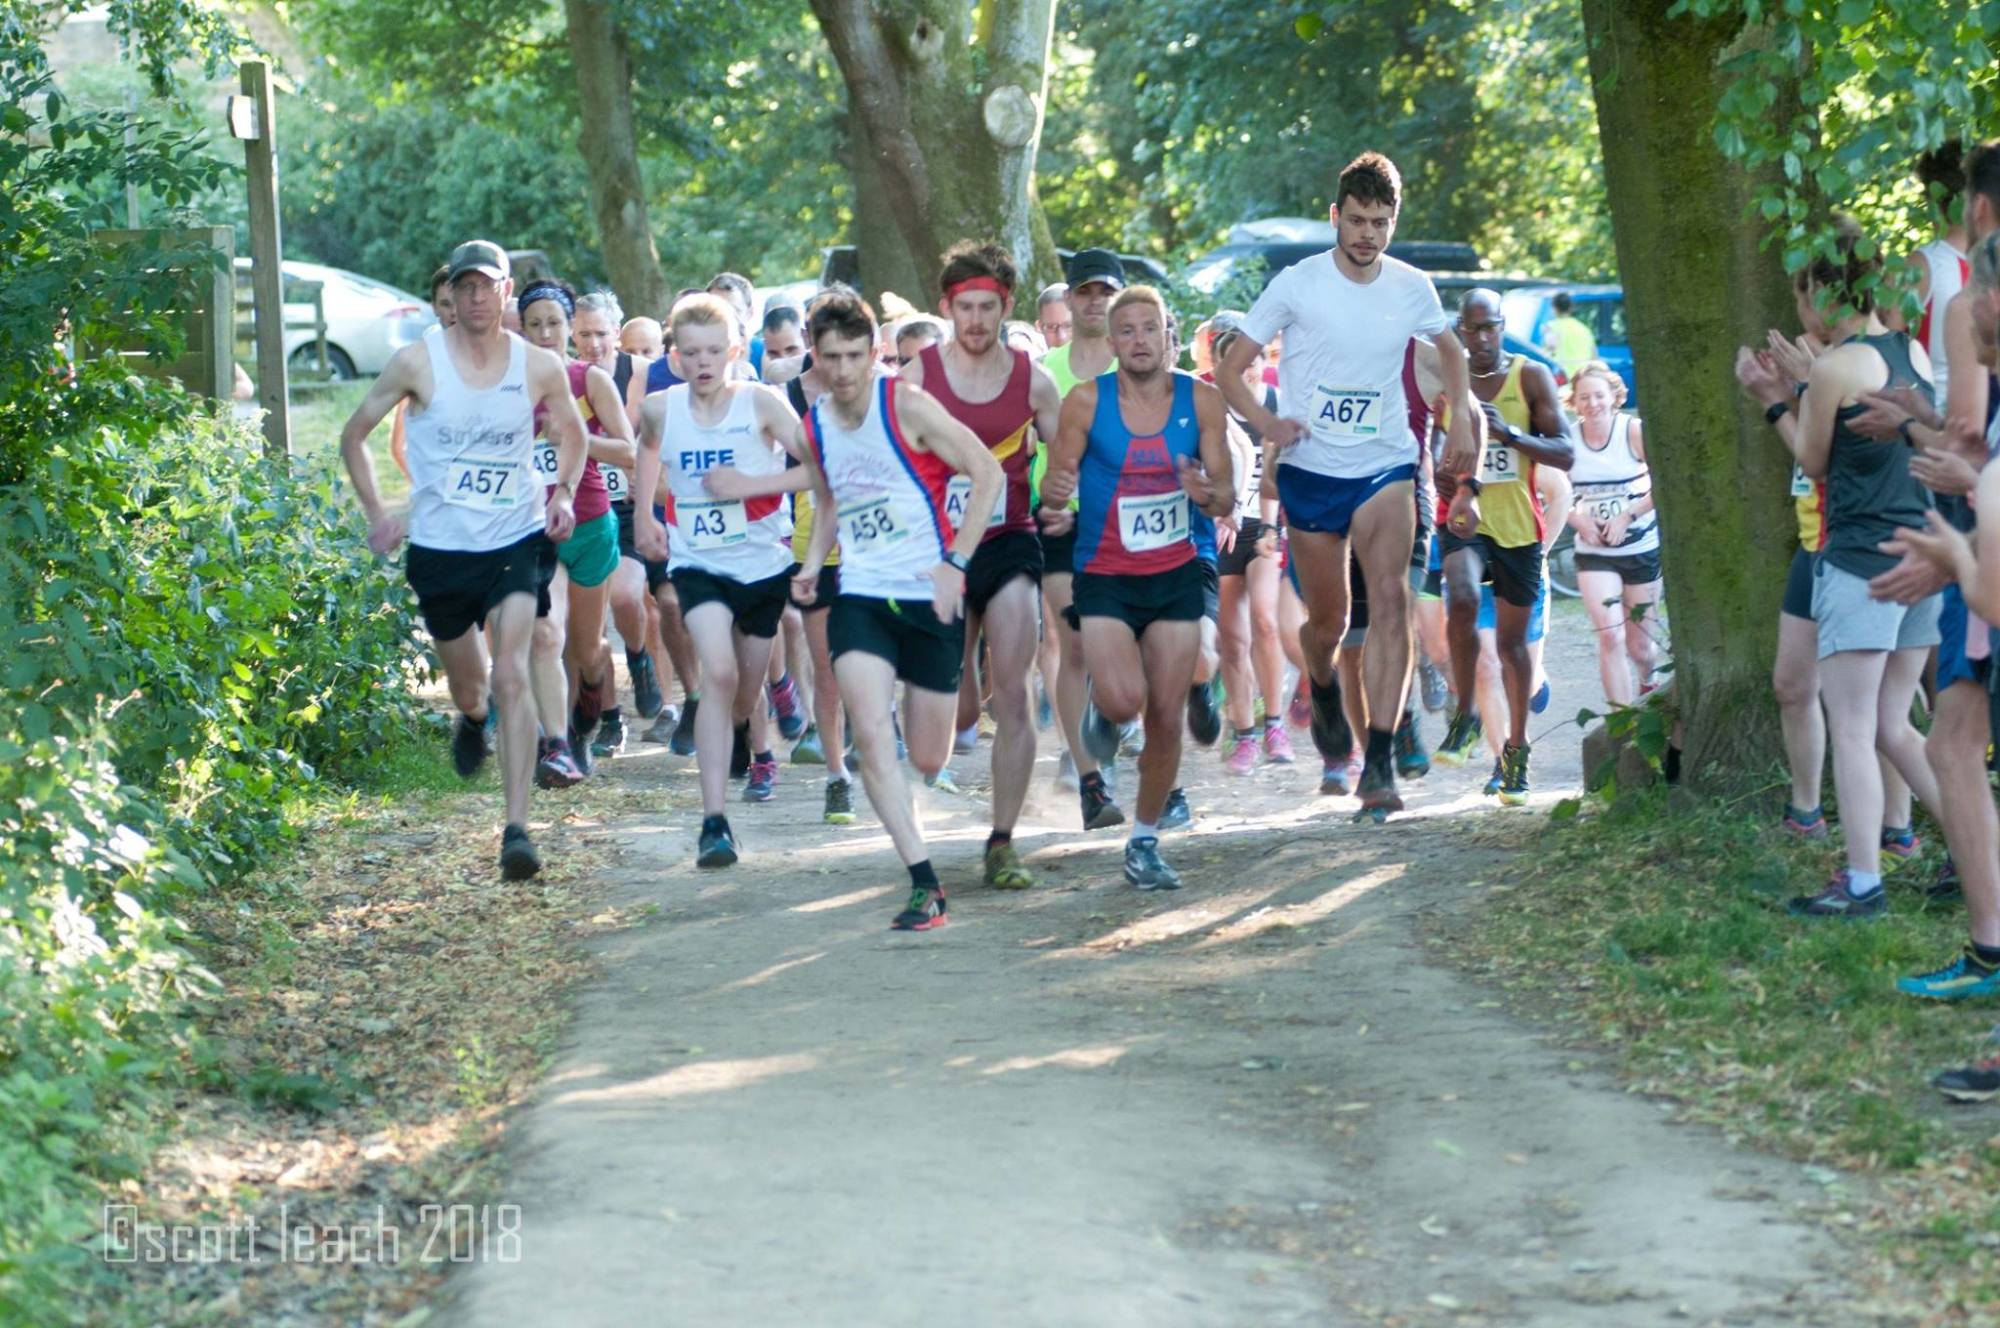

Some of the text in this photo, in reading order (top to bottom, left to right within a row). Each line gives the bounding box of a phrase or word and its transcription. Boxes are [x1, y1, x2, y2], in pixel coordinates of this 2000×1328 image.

[1319, 398, 1371, 423] A67
[680, 449, 735, 470] FIFE
[457, 470, 509, 495] A57
[693, 509, 726, 536] A3
[851, 508, 894, 543] A58
[1133, 505, 1177, 536] A31
